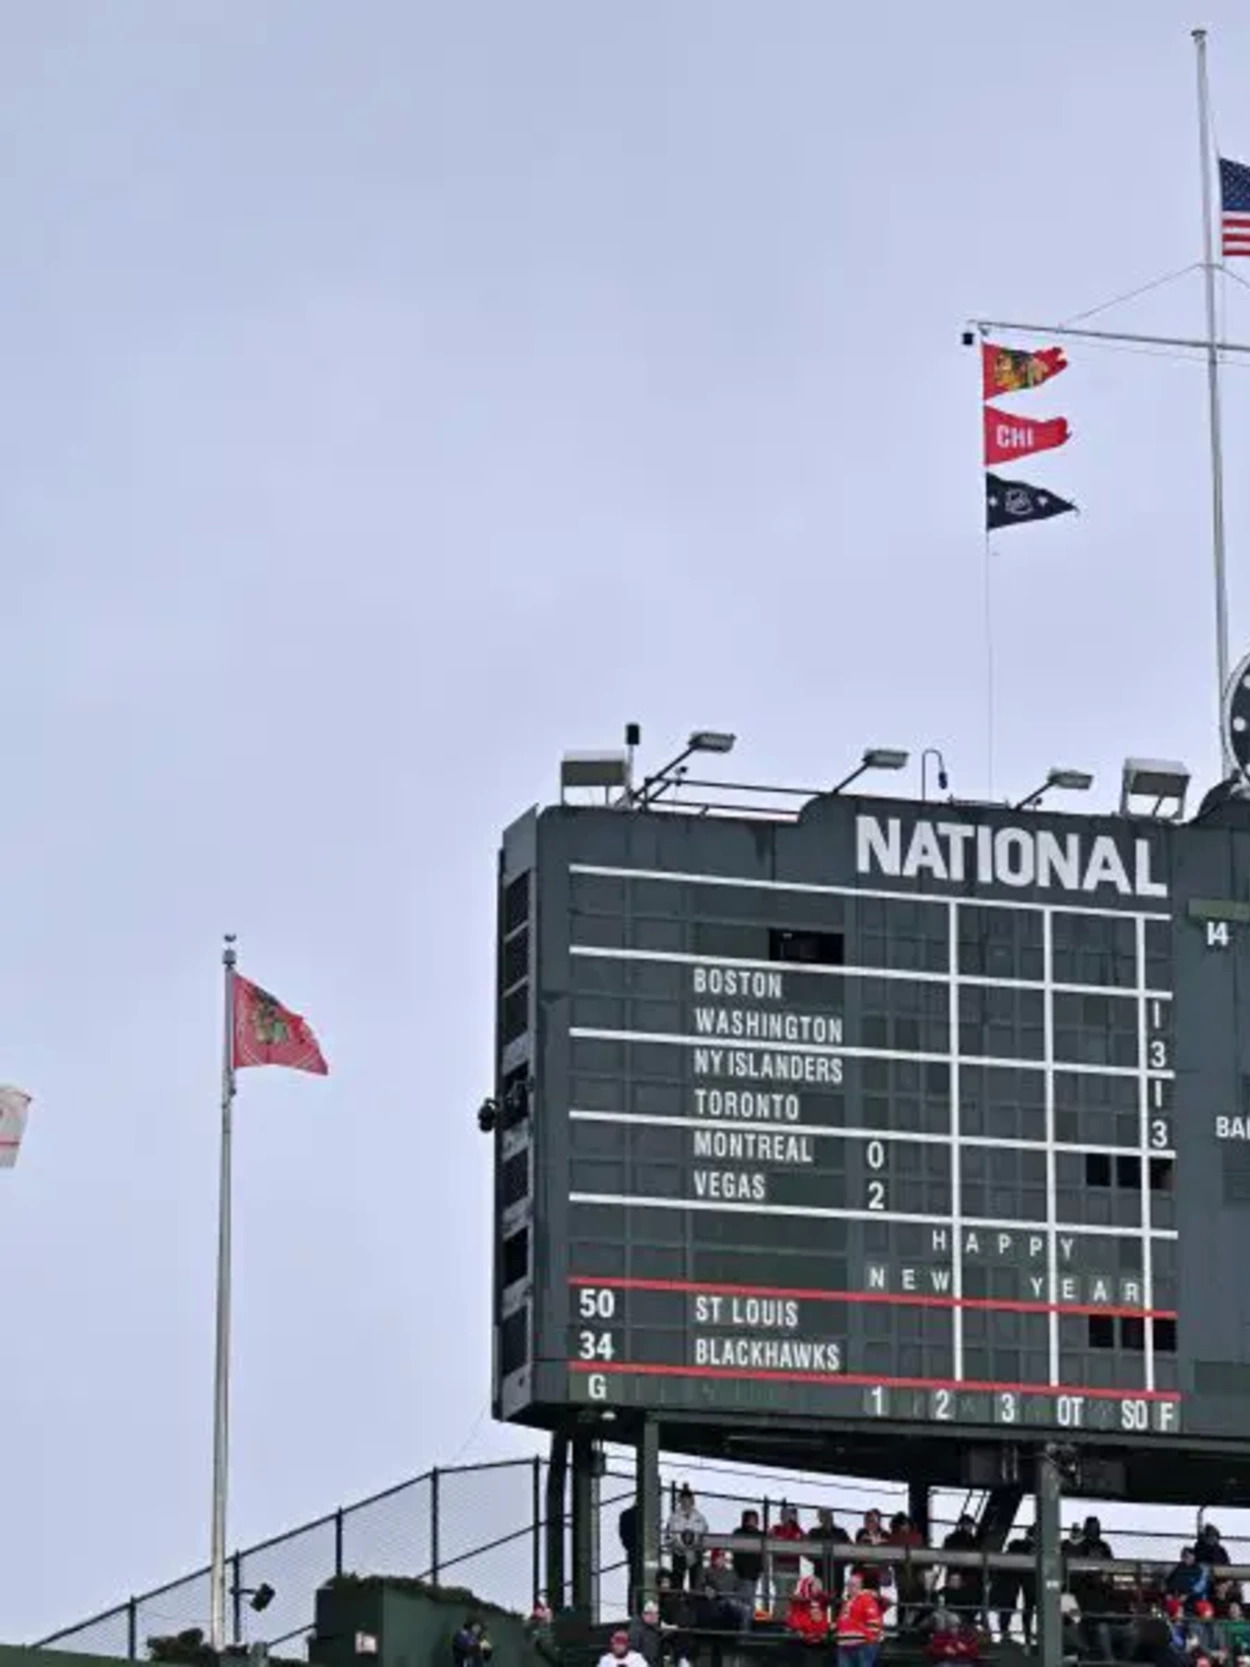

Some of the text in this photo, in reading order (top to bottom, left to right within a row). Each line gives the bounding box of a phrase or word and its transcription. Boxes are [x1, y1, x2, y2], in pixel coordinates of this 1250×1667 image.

[996, 423, 1035, 449] CHI
[853, 813, 1170, 897] NATIONAL
[1207, 921, 1230, 946] 14
[693, 967, 782, 998] BOSTON
[693, 1007, 845, 1046] WASHINGTON
[1153, 1000, 1160, 1029] 1
[694, 1048, 845, 1084] NY ISLANDERS
[1151, 1040, 1167, 1068] 3
[692, 1088, 802, 1124] TORONTO
[1154, 1080, 1162, 1108] 1
[694, 1129, 816, 1163] MONTREAL
[1151, 1119, 1168, 1149] 3
[867, 1140, 884, 1170] 0
[693, 1171, 765, 1200] VEGAS
[868, 1182, 885, 1210] 2
[867, 1265, 1141, 1304] NEW YEAR
[580, 1288, 615, 1318] 50
[695, 1295, 798, 1328] ST LOUIS
[579, 1330, 614, 1361] 34
[695, 1338, 840, 1371] BLACKHAWKS
[588, 1373, 607, 1400] G
[871, 1385, 1174, 1431] 1 2 3 OT SO F
